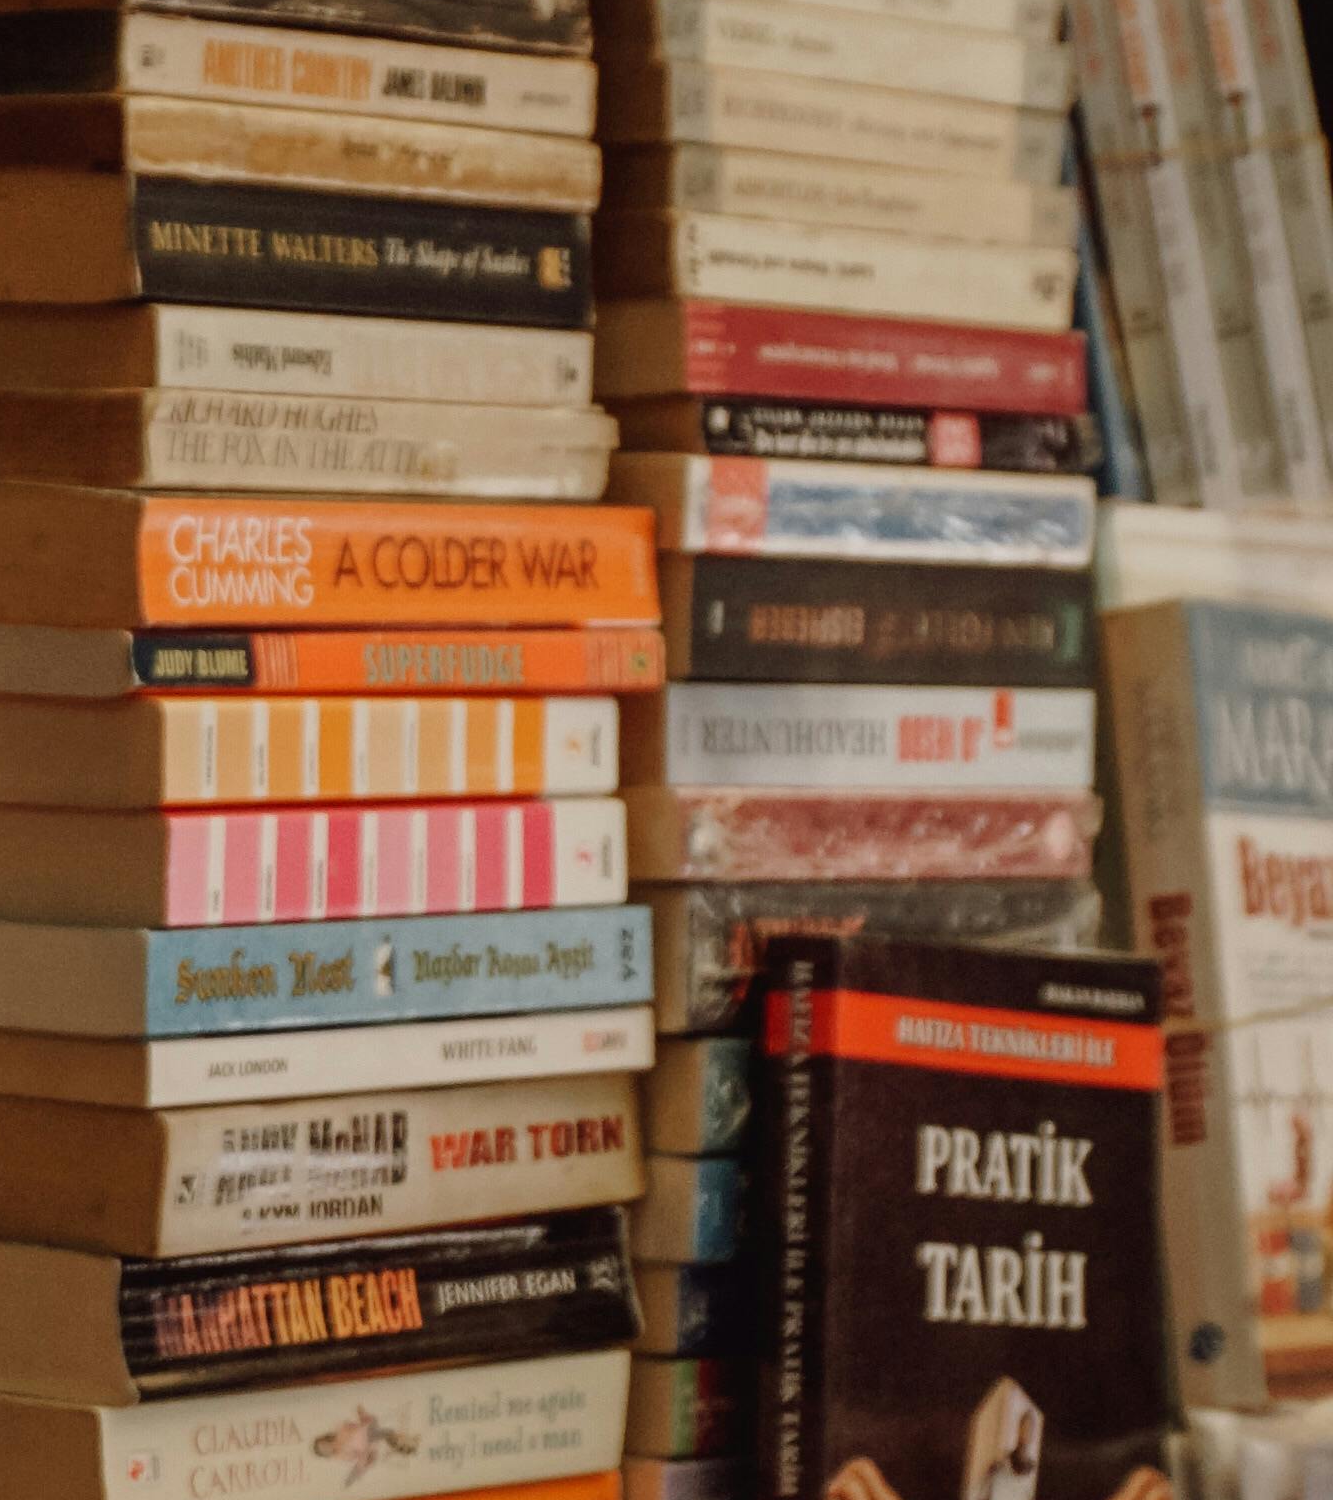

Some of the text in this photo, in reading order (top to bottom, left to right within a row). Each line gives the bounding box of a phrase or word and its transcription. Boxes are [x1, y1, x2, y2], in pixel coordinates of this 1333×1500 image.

[149, 219, 379, 270] MINETTE WALTERS
[167, 434, 352, 470] THE FOX IN THE
[166, 515, 314, 566] CHARLES
[333, 535, 600, 591] A COLDER WAR
[166, 565, 316, 608] CUMMING
[153, 643, 526, 687] JUDY BLUME SUPERFUDGE
[174, 948, 279, 1004] Sunken
[288, 947, 356, 998] Nest
[895, 1015, 963, 1051] HAFIZA
[208, 1041, 495, 1078] JACK LONDON WHITE
[429, 1115, 625, 1173] WAR TORN
[915, 1119, 1093, 1208] PRATİK
[915, 1230, 1087, 1330] TARİH
[154, 1267, 578, 1358] MANHATTAN BEACH JENNIFER EGAN
[427, 1387, 586, 1426] Remind me again
[193, 1417, 304, 1456] CLAUDIA
[540, 1427, 582, 1451] man
[189, 1461, 312, 1500] CARROLL
